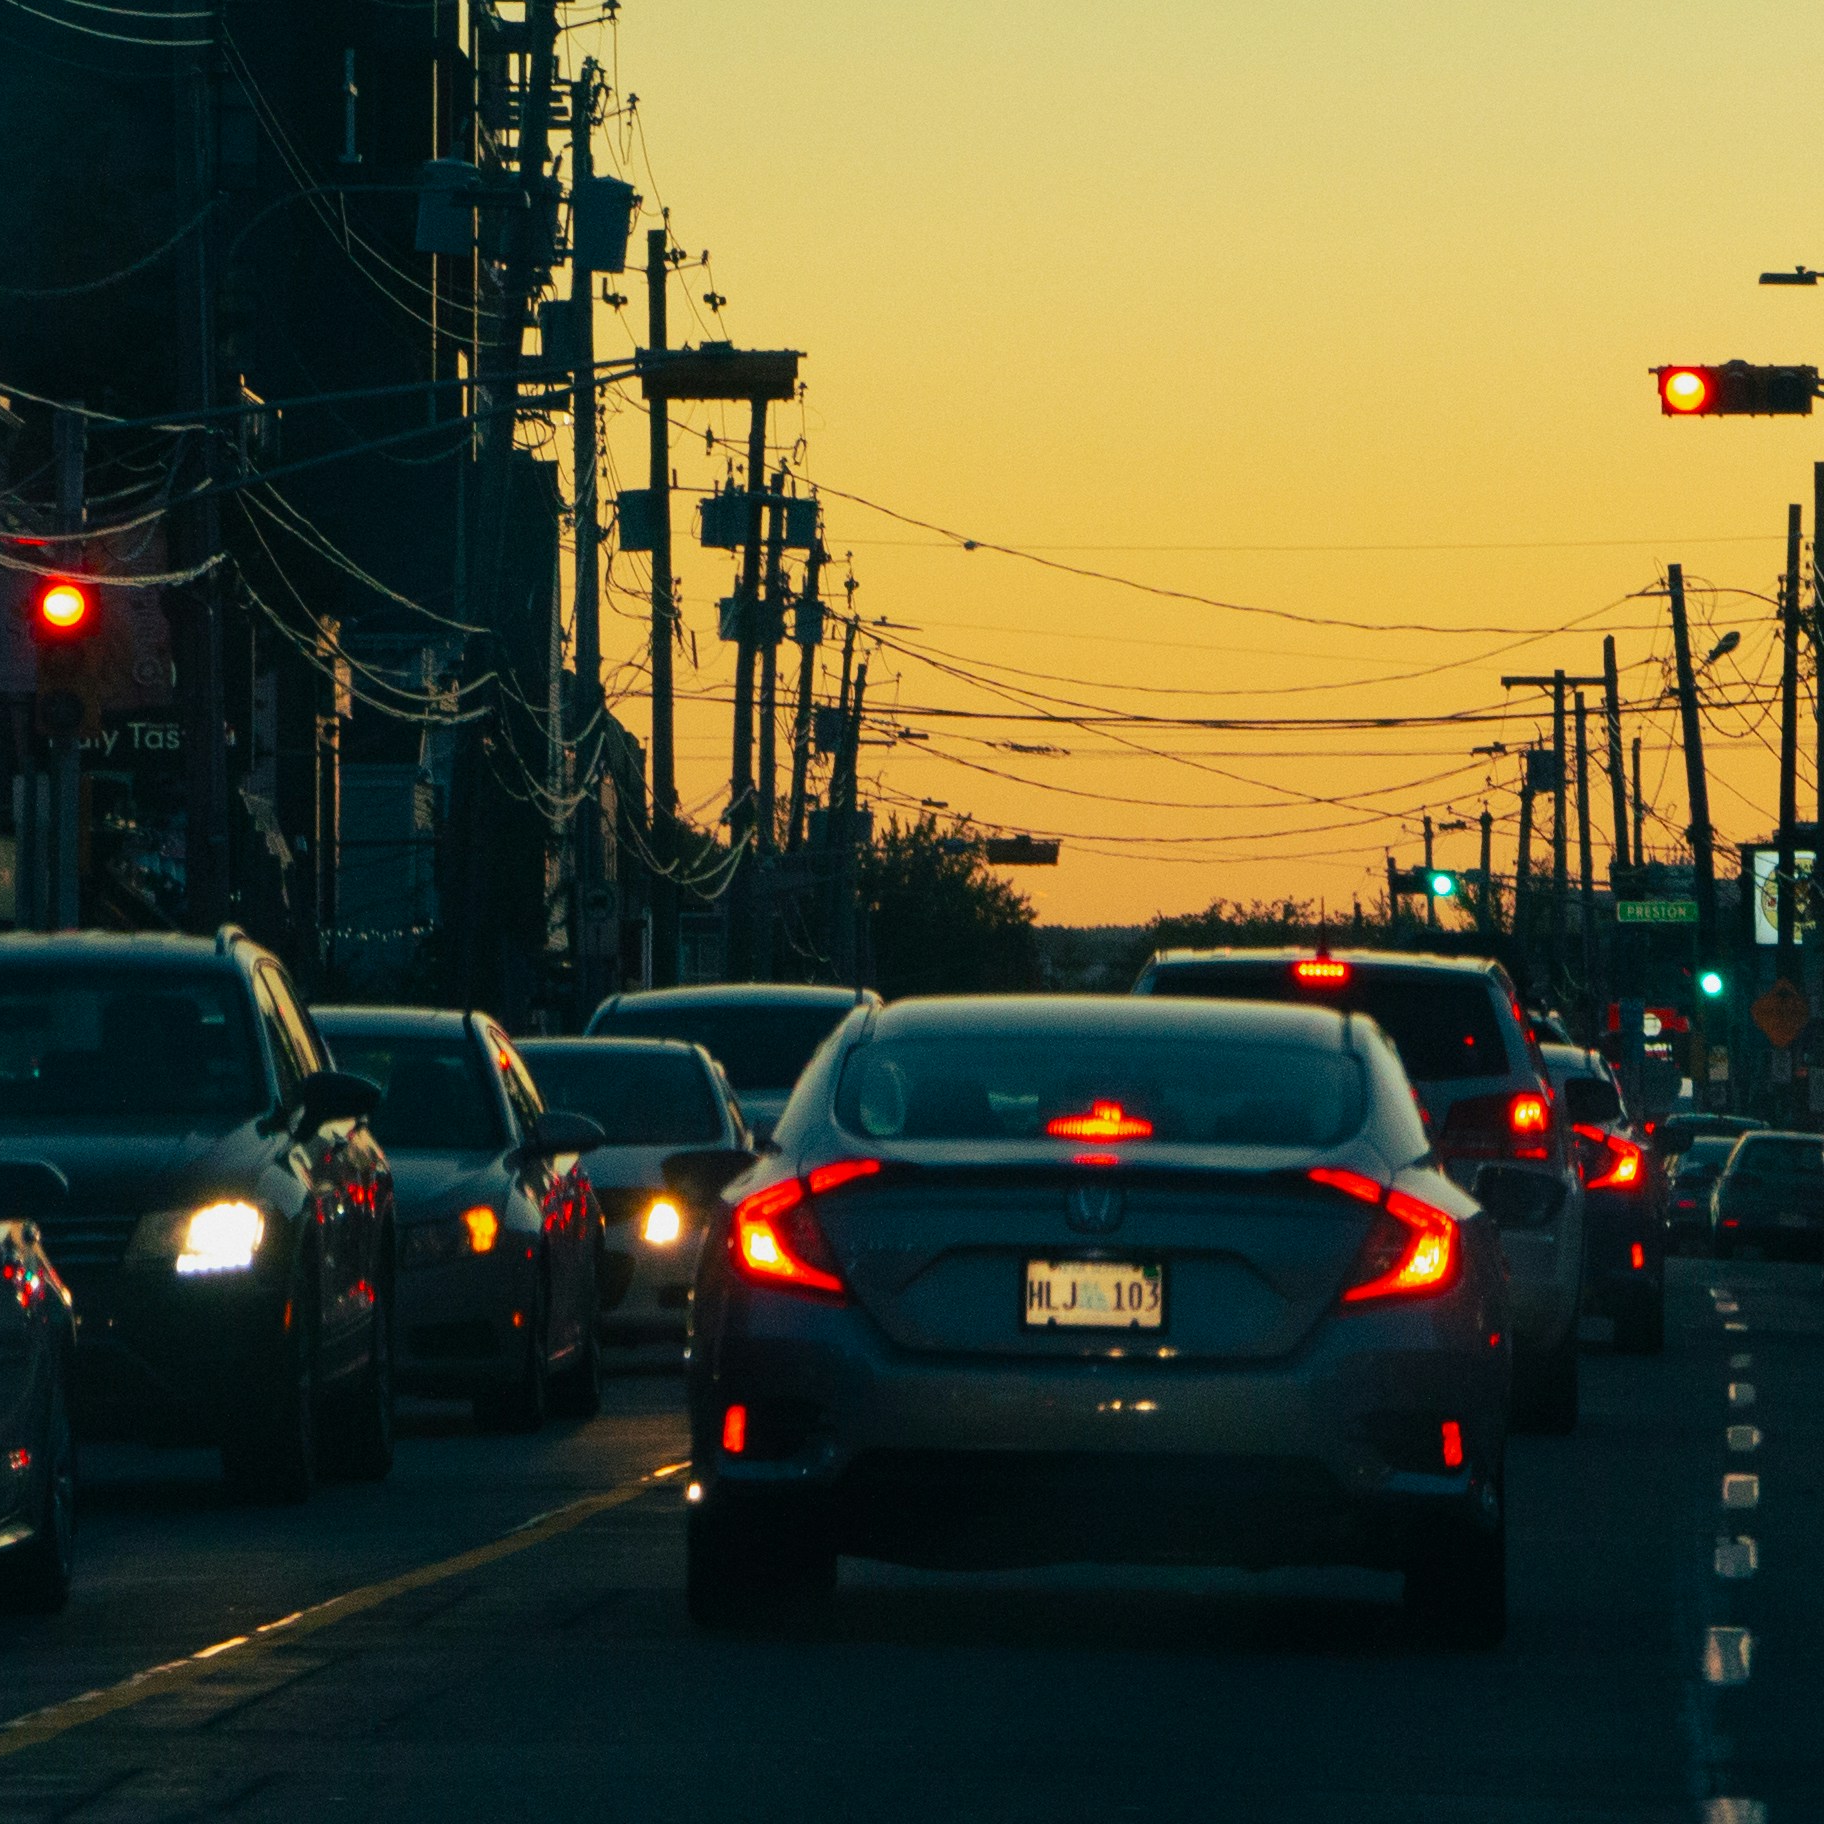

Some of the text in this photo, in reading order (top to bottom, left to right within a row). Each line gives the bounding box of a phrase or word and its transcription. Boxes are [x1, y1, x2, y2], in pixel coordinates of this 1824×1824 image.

[126, 721, 187, 750] Tas
[1626, 904, 1687, 918] PRESTON
[1028, 1280, 1160, 1312] HLJ 103
